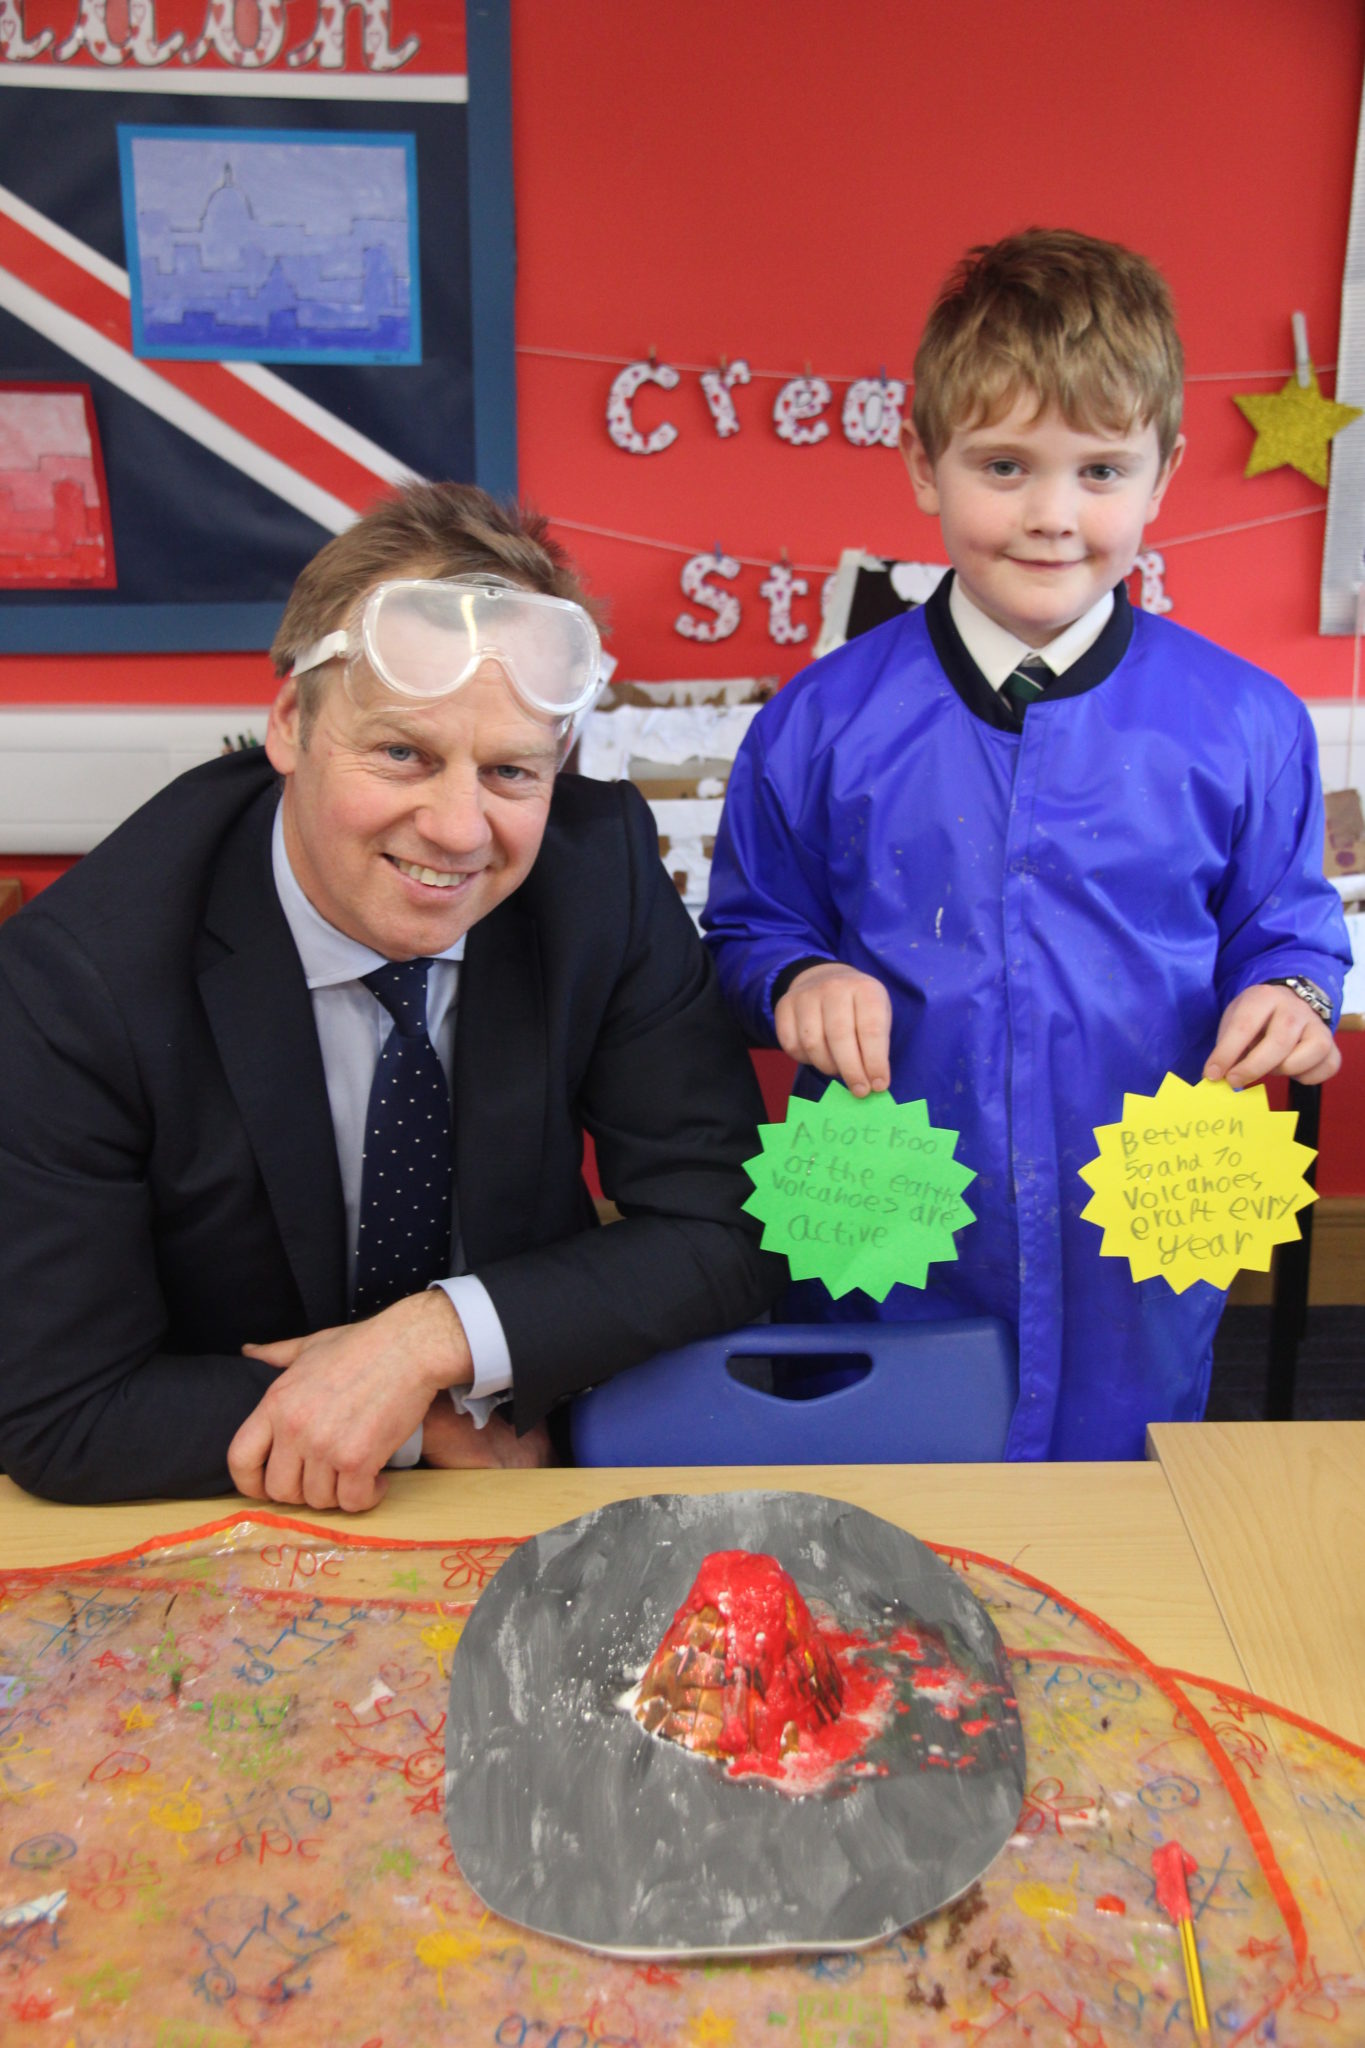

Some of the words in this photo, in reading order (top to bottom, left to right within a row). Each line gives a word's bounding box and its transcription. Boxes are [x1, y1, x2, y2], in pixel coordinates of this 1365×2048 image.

[827, 1156, 875, 1190] the
[1158, 1154, 1202, 1177] and
[1158, 1230, 1253, 1266] year
